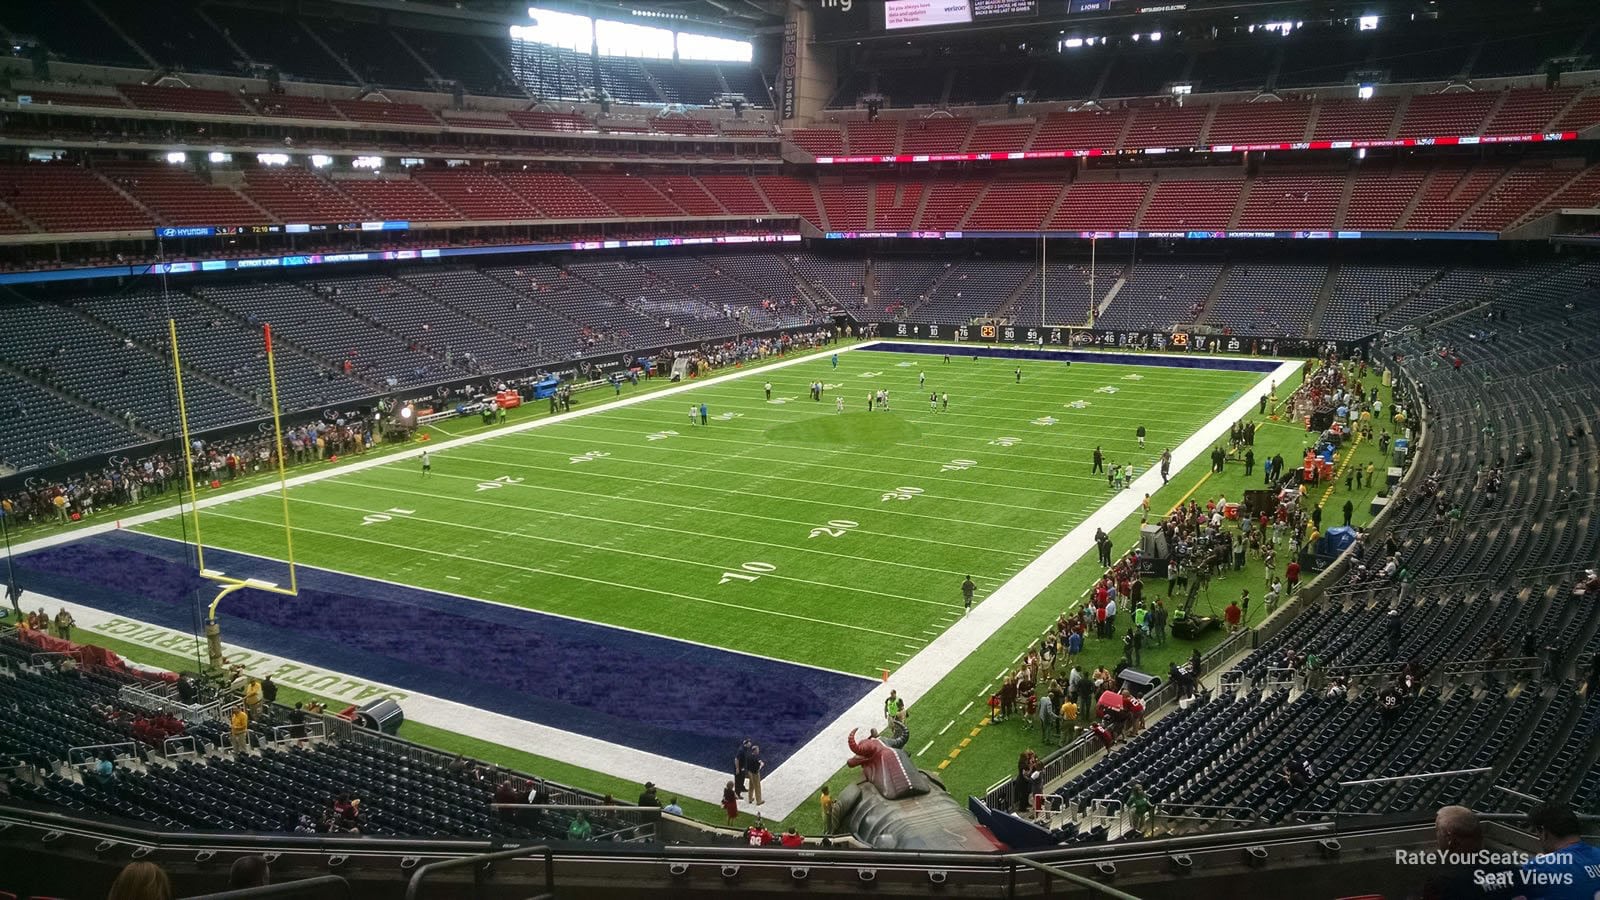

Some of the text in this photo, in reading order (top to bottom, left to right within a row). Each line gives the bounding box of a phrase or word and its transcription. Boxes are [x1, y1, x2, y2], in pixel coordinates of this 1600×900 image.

[784, 42, 796, 79] HOU
[177, 228, 208, 236] HYUNDAI
[238, 258, 279, 268] DETROIT LIONS
[897, 326, 906, 335] 56
[930, 328, 938, 336] 10
[958, 329, 968, 337] 76
[983, 328, 993, 337] 25
[1004, 331, 1014, 339] 90
[1026, 332, 1037, 340] 99
[1104, 335, 1115, 343] 46
[1174, 336, 1186, 344] 25
[1228, 341, 1240, 349] 29
[595, 361, 618, 369] TEXANS
[402, 396, 432, 406] TXANS
[569, 450, 611, 462] 30
[941, 459, 977, 471] 40
[475, 475, 524, 489] 20
[882, 486, 925, 500] 30
[362, 507, 416, 523] 10
[809, 519, 859, 538] 20
[721, 561, 776, 583] 10
[1385, 696, 1396, 706] 99
